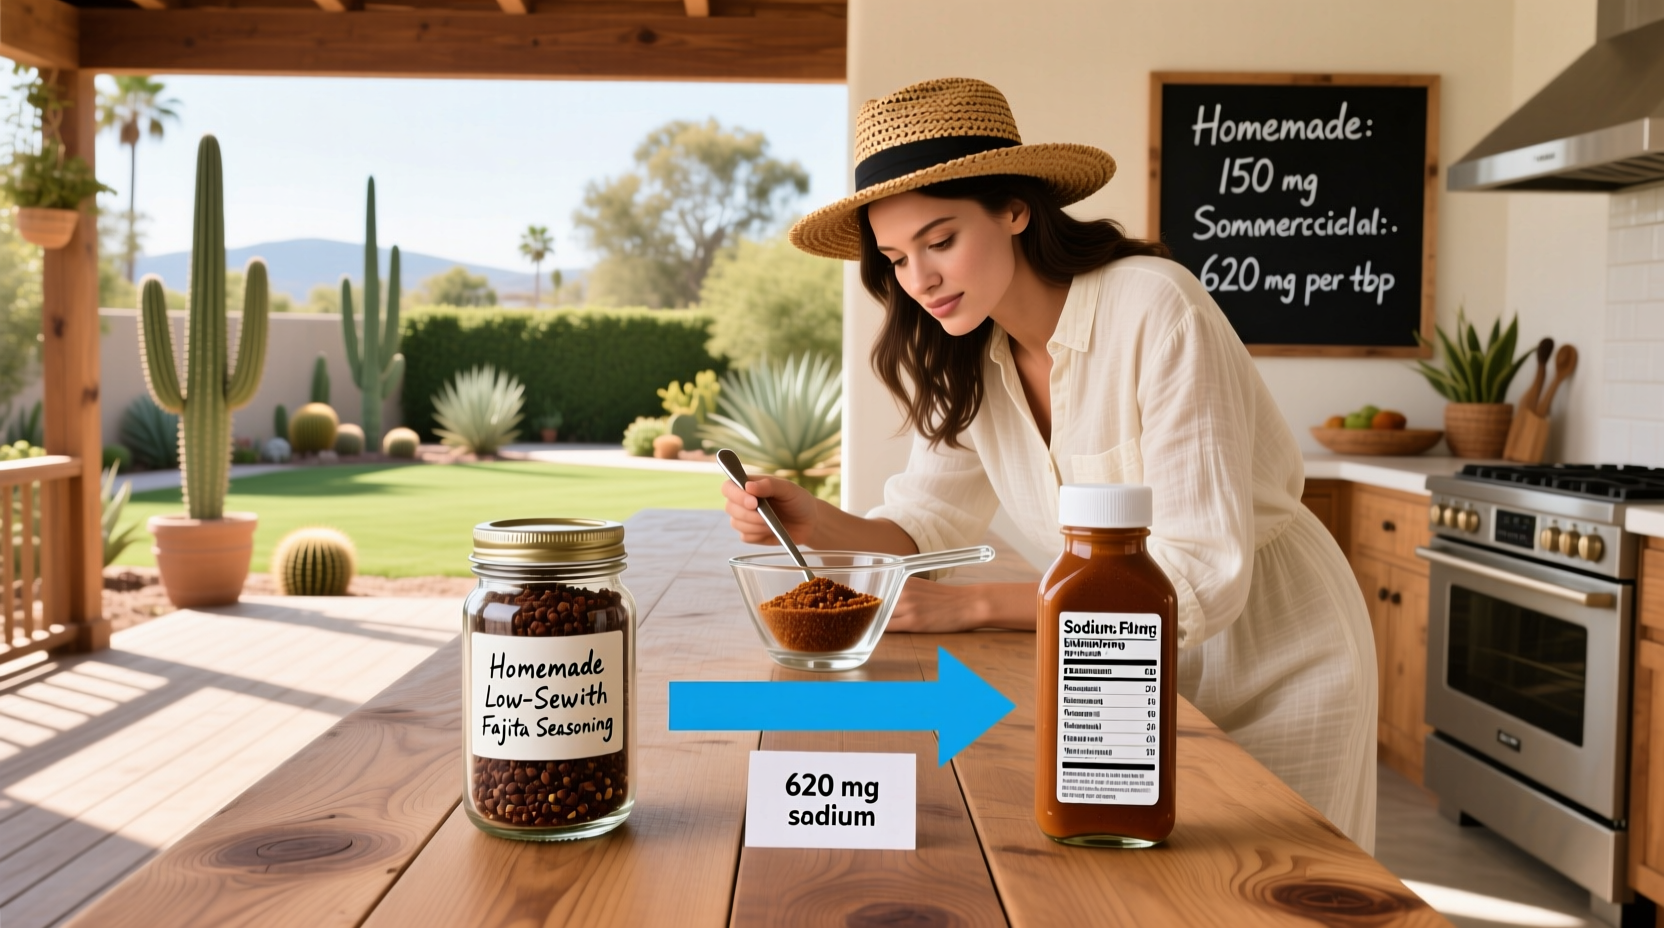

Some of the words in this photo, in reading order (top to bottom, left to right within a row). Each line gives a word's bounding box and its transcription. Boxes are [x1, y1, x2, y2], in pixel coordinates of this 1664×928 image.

[1191, 101, 1373, 146] Homemade:
[1219, 157, 1275, 195] 150
[1281, 173, 1318, 207] mg
[1200, 253, 1260, 292] 620
[1264, 273, 1297, 304] mg
[1304, 273, 1345, 307] per
[1349, 260, 1396, 305] tbp
[490, 648, 605, 680] Homemade
[485, 681, 608, 710] Low-Sewith
[482, 715, 530, 746] Fajita
[536, 717, 614, 743] Seasoning
[785, 772, 834, 797] 620
[841, 780, 879, 804] mg
